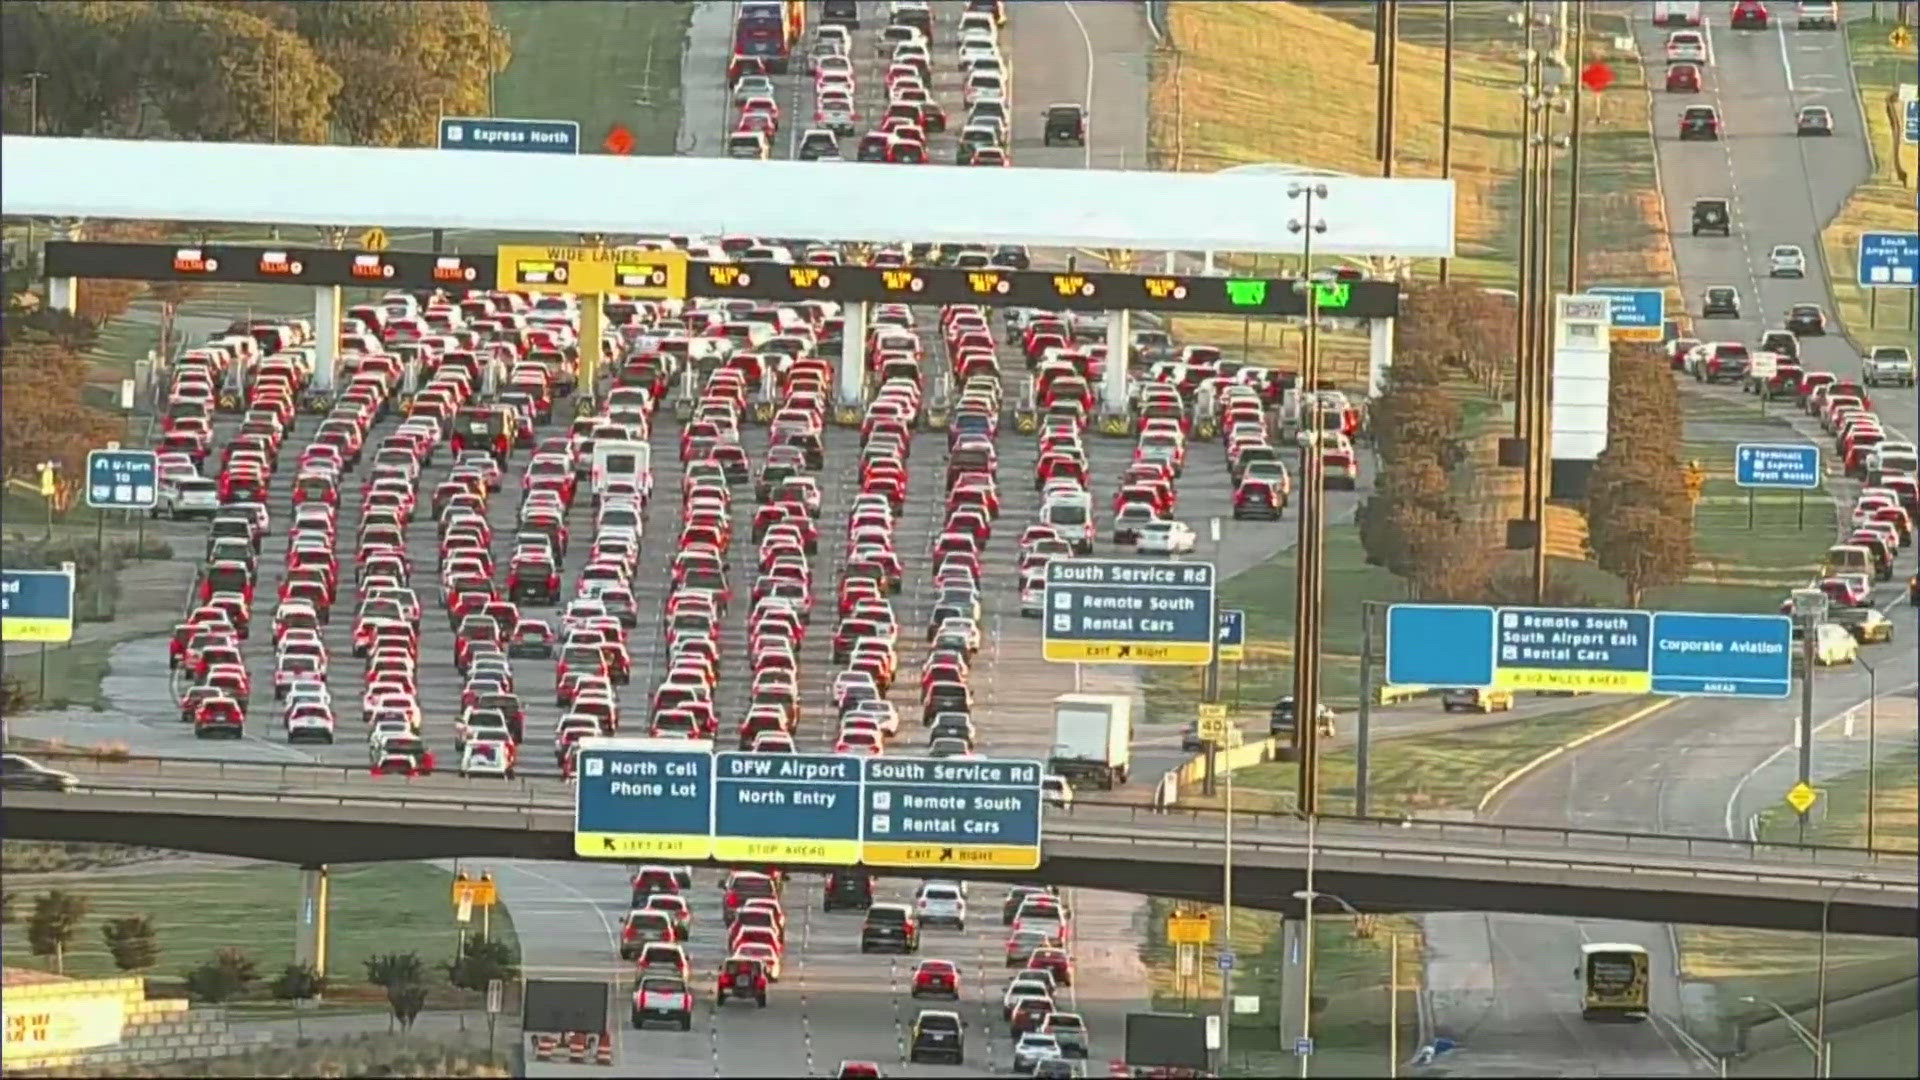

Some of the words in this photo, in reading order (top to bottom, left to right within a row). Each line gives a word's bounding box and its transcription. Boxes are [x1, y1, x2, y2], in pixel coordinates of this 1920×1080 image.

[473, 128, 524, 143] Express
[531, 130, 569, 144] North
[547, 248, 586, 261] WIDE
[592, 250, 640, 263] LANES
[1053, 565, 1103, 580] South
[1111, 566, 1176, 582] Service
[1184, 568, 1206, 583] Rd
[1083, 595, 1142, 609] Remote
[1151, 597, 1194, 611] South
[1083, 616, 1133, 631] Rental
[1140, 618, 1174, 632] Cars
[1524, 615, 1579, 629] Remote
[1585, 617, 1629, 630] South
[1503, 631, 1545, 644] South
[1552, 632, 1605, 647] Airport
[1610, 633, 1638, 647] Exit
[1659, 639, 1724, 653] Corporate
[1729, 641, 1783, 654] Aviation
[1523, 647, 1570, 660] Rental
[1577, 649, 1609, 661] Cars
[1703, 683, 1737, 692] AHEAD
[610, 761, 657, 775] North
[665, 762, 698, 776] Cell
[731, 759, 771, 775] DFW
[780, 760, 846, 780] Airport
[871, 763, 925, 779] South
[934, 765, 1001, 781] Service
[1010, 767, 1034, 782] Rd
[610, 781, 663, 796] Phone
[670, 782, 697, 797] Lot
[738, 789, 785, 804] North
[793, 791, 836, 809] Entry
[903, 794, 966, 809] Remote
[974, 796, 1022, 811] South
[903, 817, 956, 832] Rental
[963, 819, 1000, 834] Cars
[747, 844, 778, 855] STOP
[906, 849, 931, 860] EXIT
[959, 850, 993, 861] RIGHT
